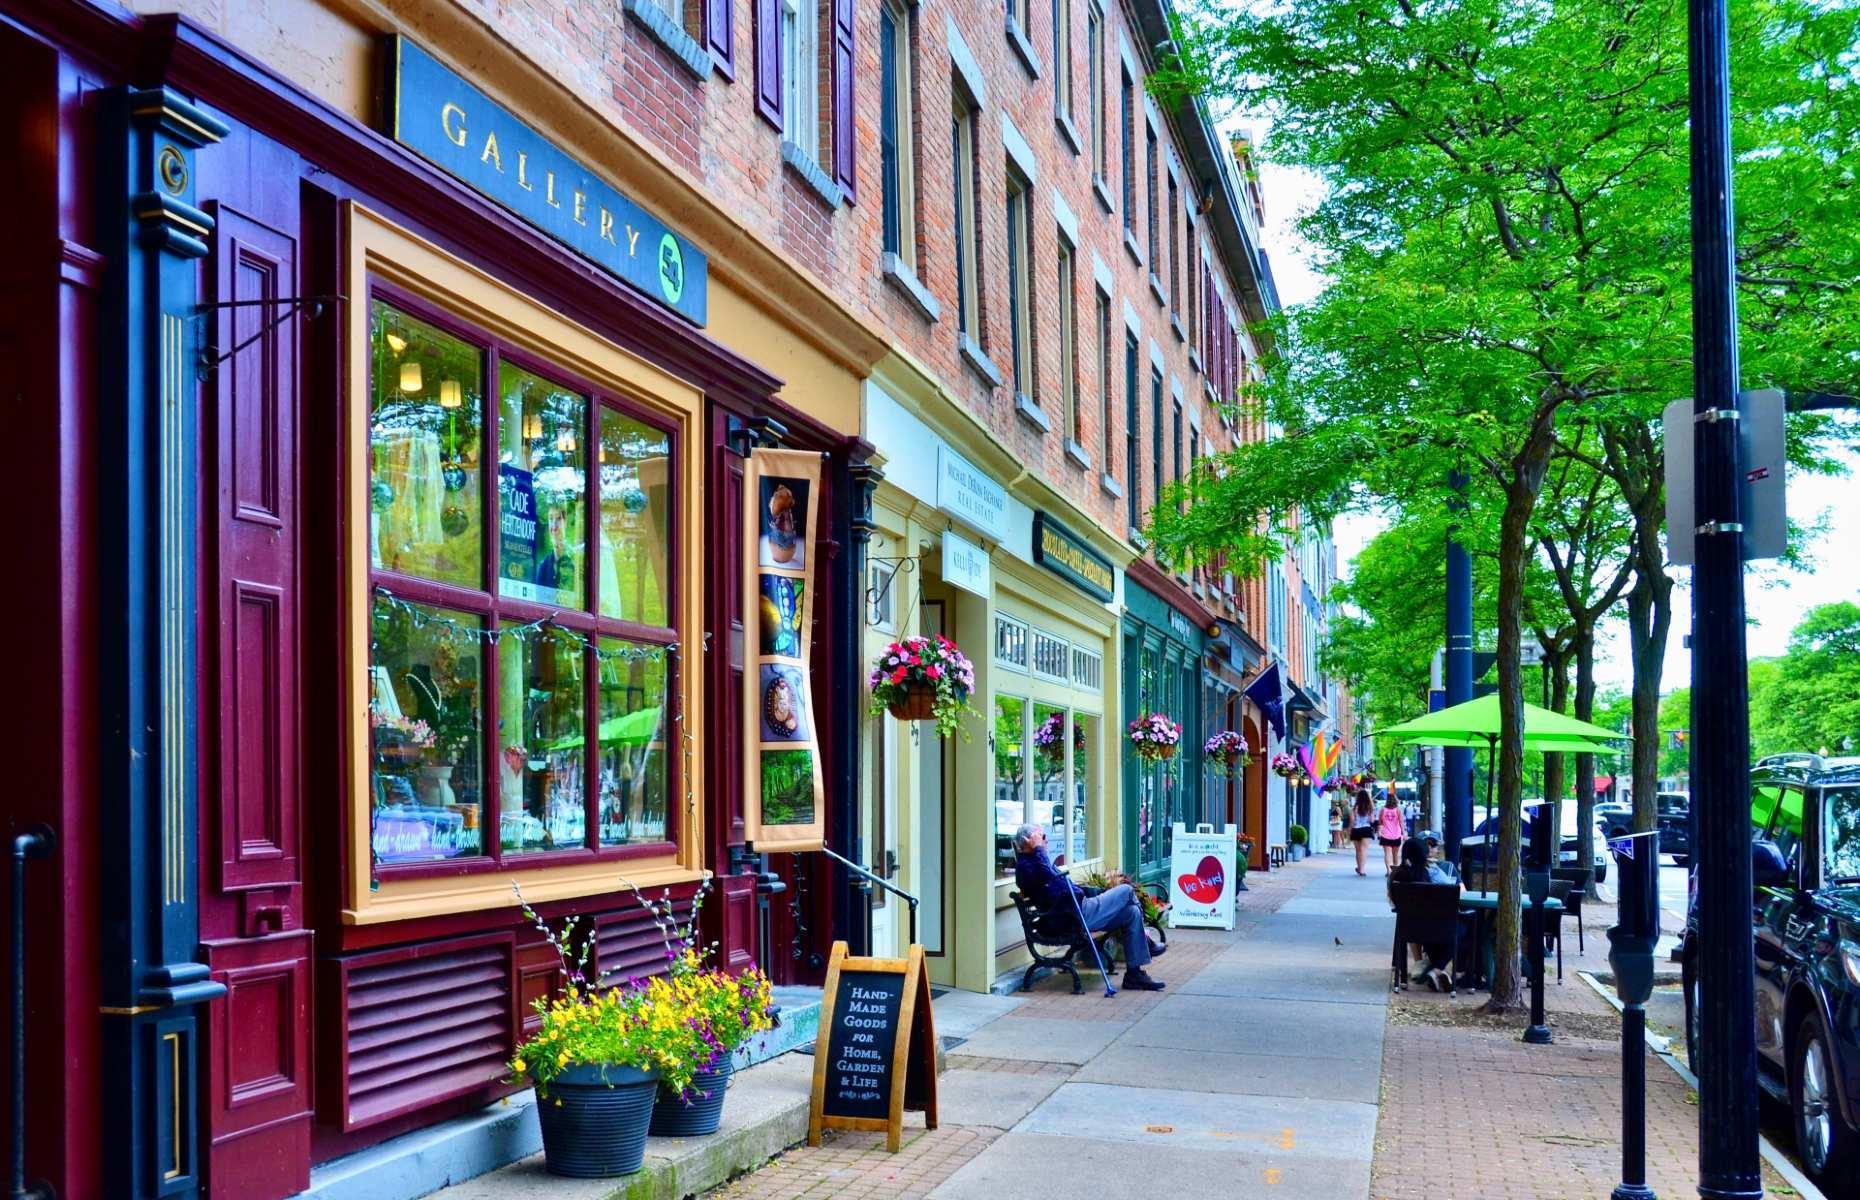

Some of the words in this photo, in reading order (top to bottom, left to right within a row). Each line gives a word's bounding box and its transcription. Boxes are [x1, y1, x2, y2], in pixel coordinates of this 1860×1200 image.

[441, 102, 640, 257] GALLERY
[661, 244, 681, 293] 54
[509, 488, 529, 514] CADE
[957, 490, 972, 511] REAL
[975, 502, 994, 522] ESTATE
[1184, 881, 1197, 894] be
[1198, 872, 1223, 888] kind
[852, 987, 894, 999] HAND-
[849, 1001, 887, 1013] MADE
[844, 1016, 887, 1029] GOODS
[852, 1033, 874, 1042] FOR
[843, 1047, 882, 1060] HOME,
[837, 1060, 885, 1073] GARDEN
[841, 1078, 850, 1087] &
[852, 1076, 878, 1087] LIFE
